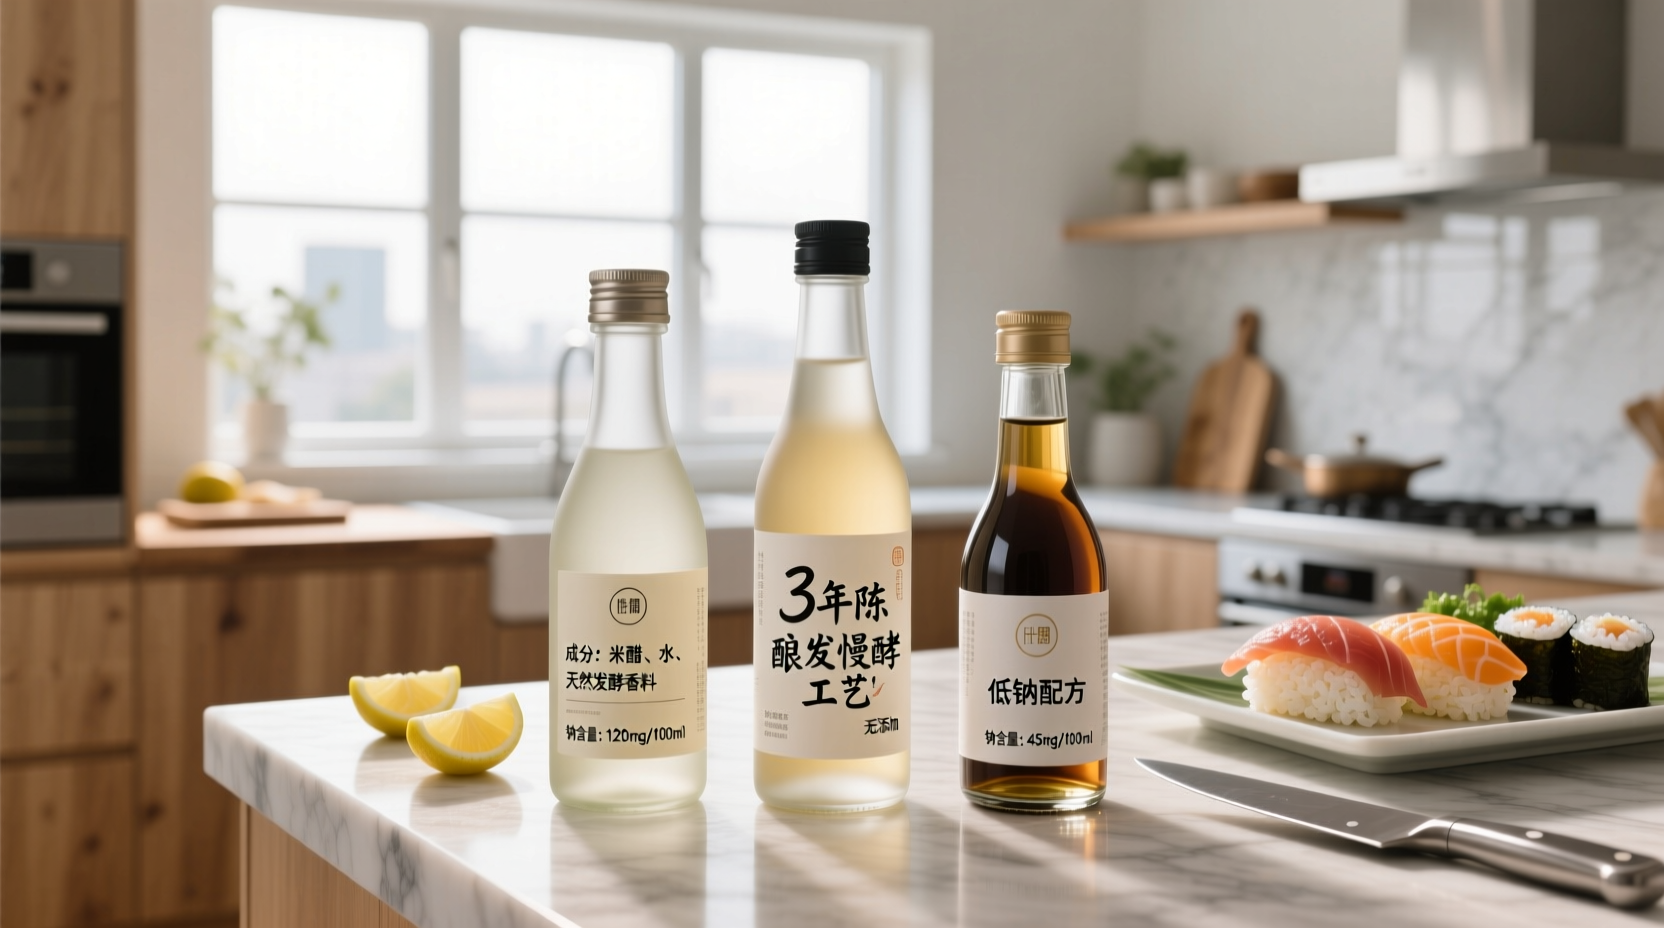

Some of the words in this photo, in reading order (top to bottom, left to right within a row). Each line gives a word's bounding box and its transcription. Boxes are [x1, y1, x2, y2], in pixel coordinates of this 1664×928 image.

[779, 565, 889, 625] 3年陈
[771, 629, 901, 673] 酿发慢酵
[565, 671, 657, 692] 天然发酵香料
[987, 677, 1086, 706] 低钠配方
